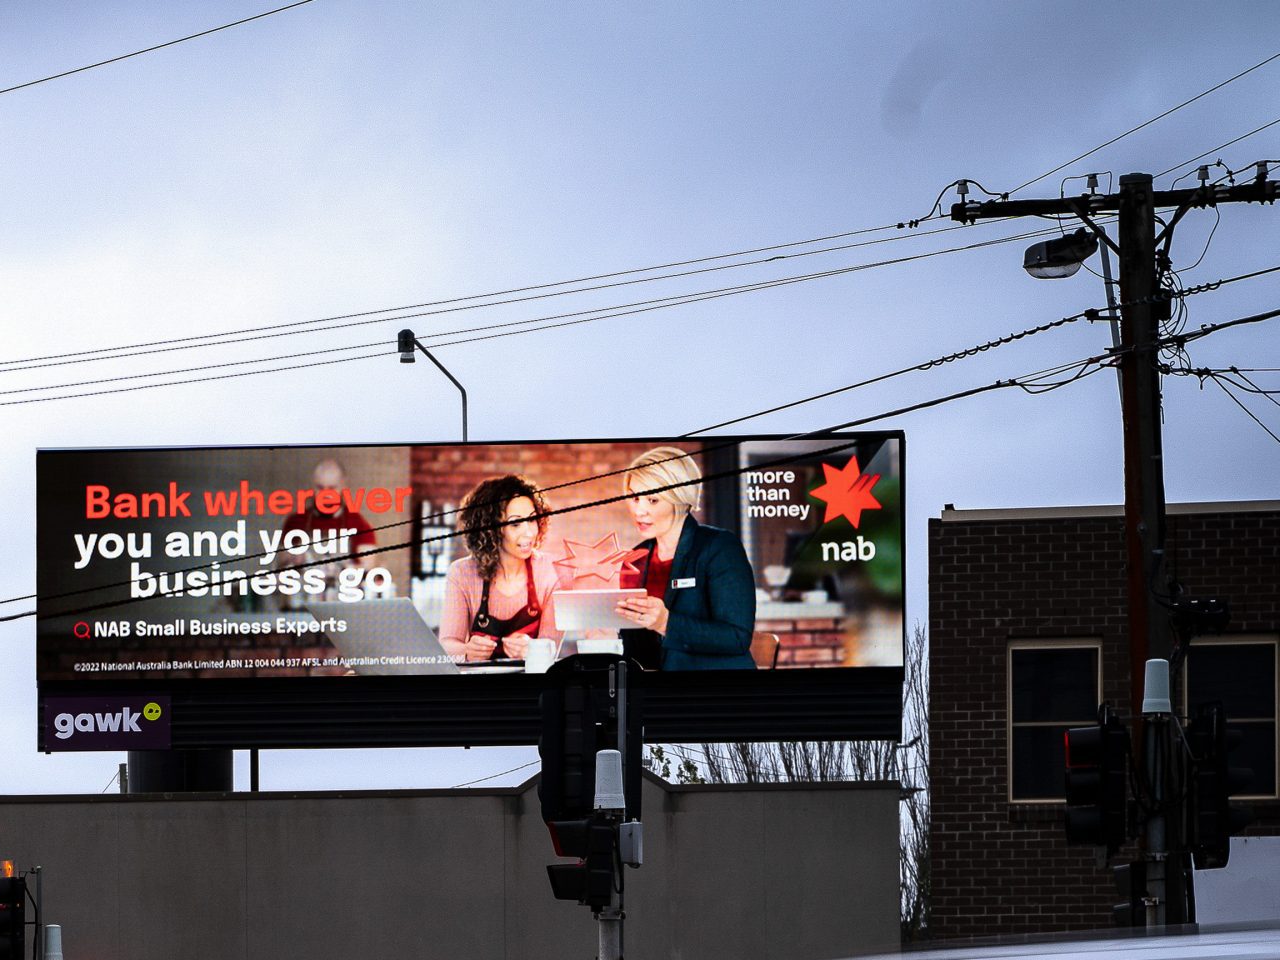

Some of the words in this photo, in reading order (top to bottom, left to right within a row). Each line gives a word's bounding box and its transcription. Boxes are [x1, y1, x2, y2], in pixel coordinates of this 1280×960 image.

[746, 470, 795, 484] more
[85, 481, 192, 519] Bank
[204, 480, 412, 516] wherever
[747, 486, 790, 501] than
[748, 503, 810, 520] money
[73, 531, 152, 569] you
[165, 519, 246, 557] and
[259, 528, 357, 564] your
[821, 535, 876, 562] nab
[130, 561, 326, 599] business
[338, 565, 392, 603] go
[94, 621, 131, 638] NAB
[135, 619, 185, 637] Small
[190, 618, 272, 636] Business
[276, 617, 347, 637] Experts
[101, 661, 135, 671] National
[136, 660, 171, 671] Australia
[172, 660, 193, 670] Bank
[194, 659, 224, 669] Limited
[225, 659, 243, 668] ABN
[244, 658, 254, 668] 12
[254, 658, 269, 668] 004
[270, 658, 285, 667] 044
[285, 658, 301, 667] 937
[302, 657, 322, 667] AFSL
[323, 657, 339, 667] and
[339, 656, 379, 667] Australian
[380, 656, 405, 665] Credit
[406, 655, 436, 665] Licence
[54, 706, 142, 739] gawk
